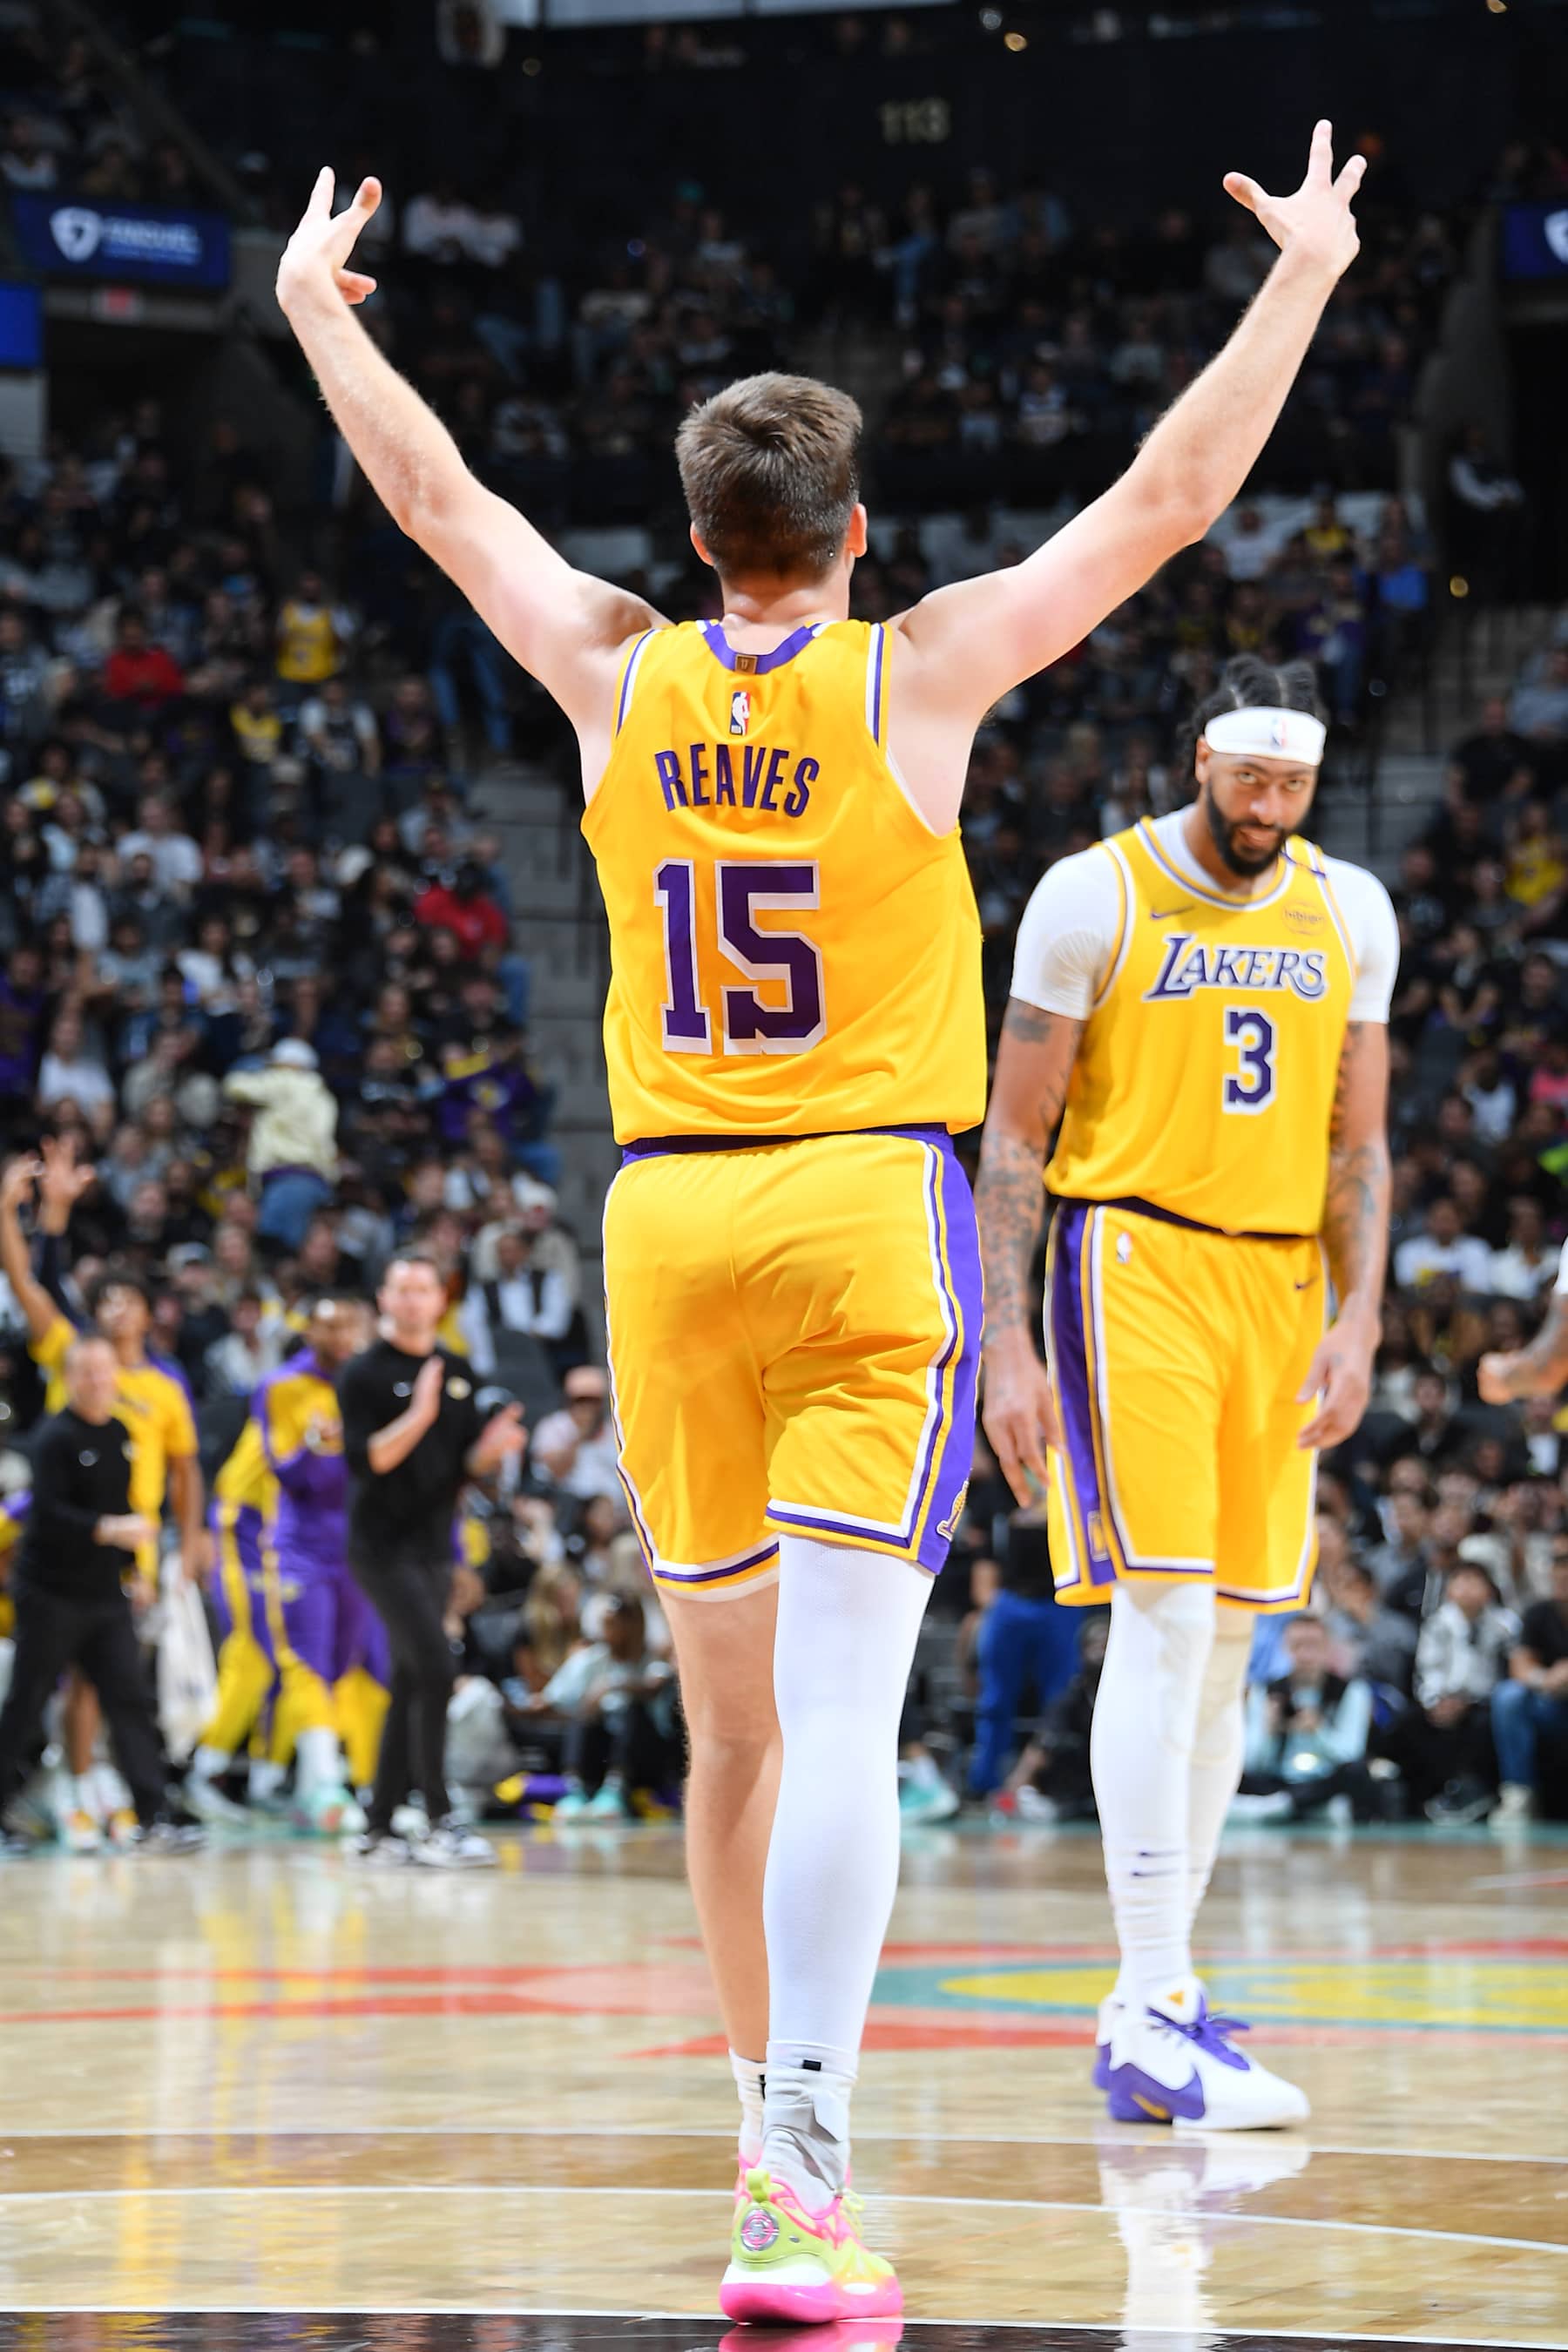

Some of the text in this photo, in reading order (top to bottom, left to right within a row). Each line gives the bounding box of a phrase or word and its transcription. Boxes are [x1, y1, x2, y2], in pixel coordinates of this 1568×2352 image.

[880, 98, 950, 144] 113
[654, 742, 821, 818] REAVES
[653, 857, 828, 1056] 15
[1141, 933, 1329, 1001] LAKERS
[1222, 1006, 1278, 1114] 3
